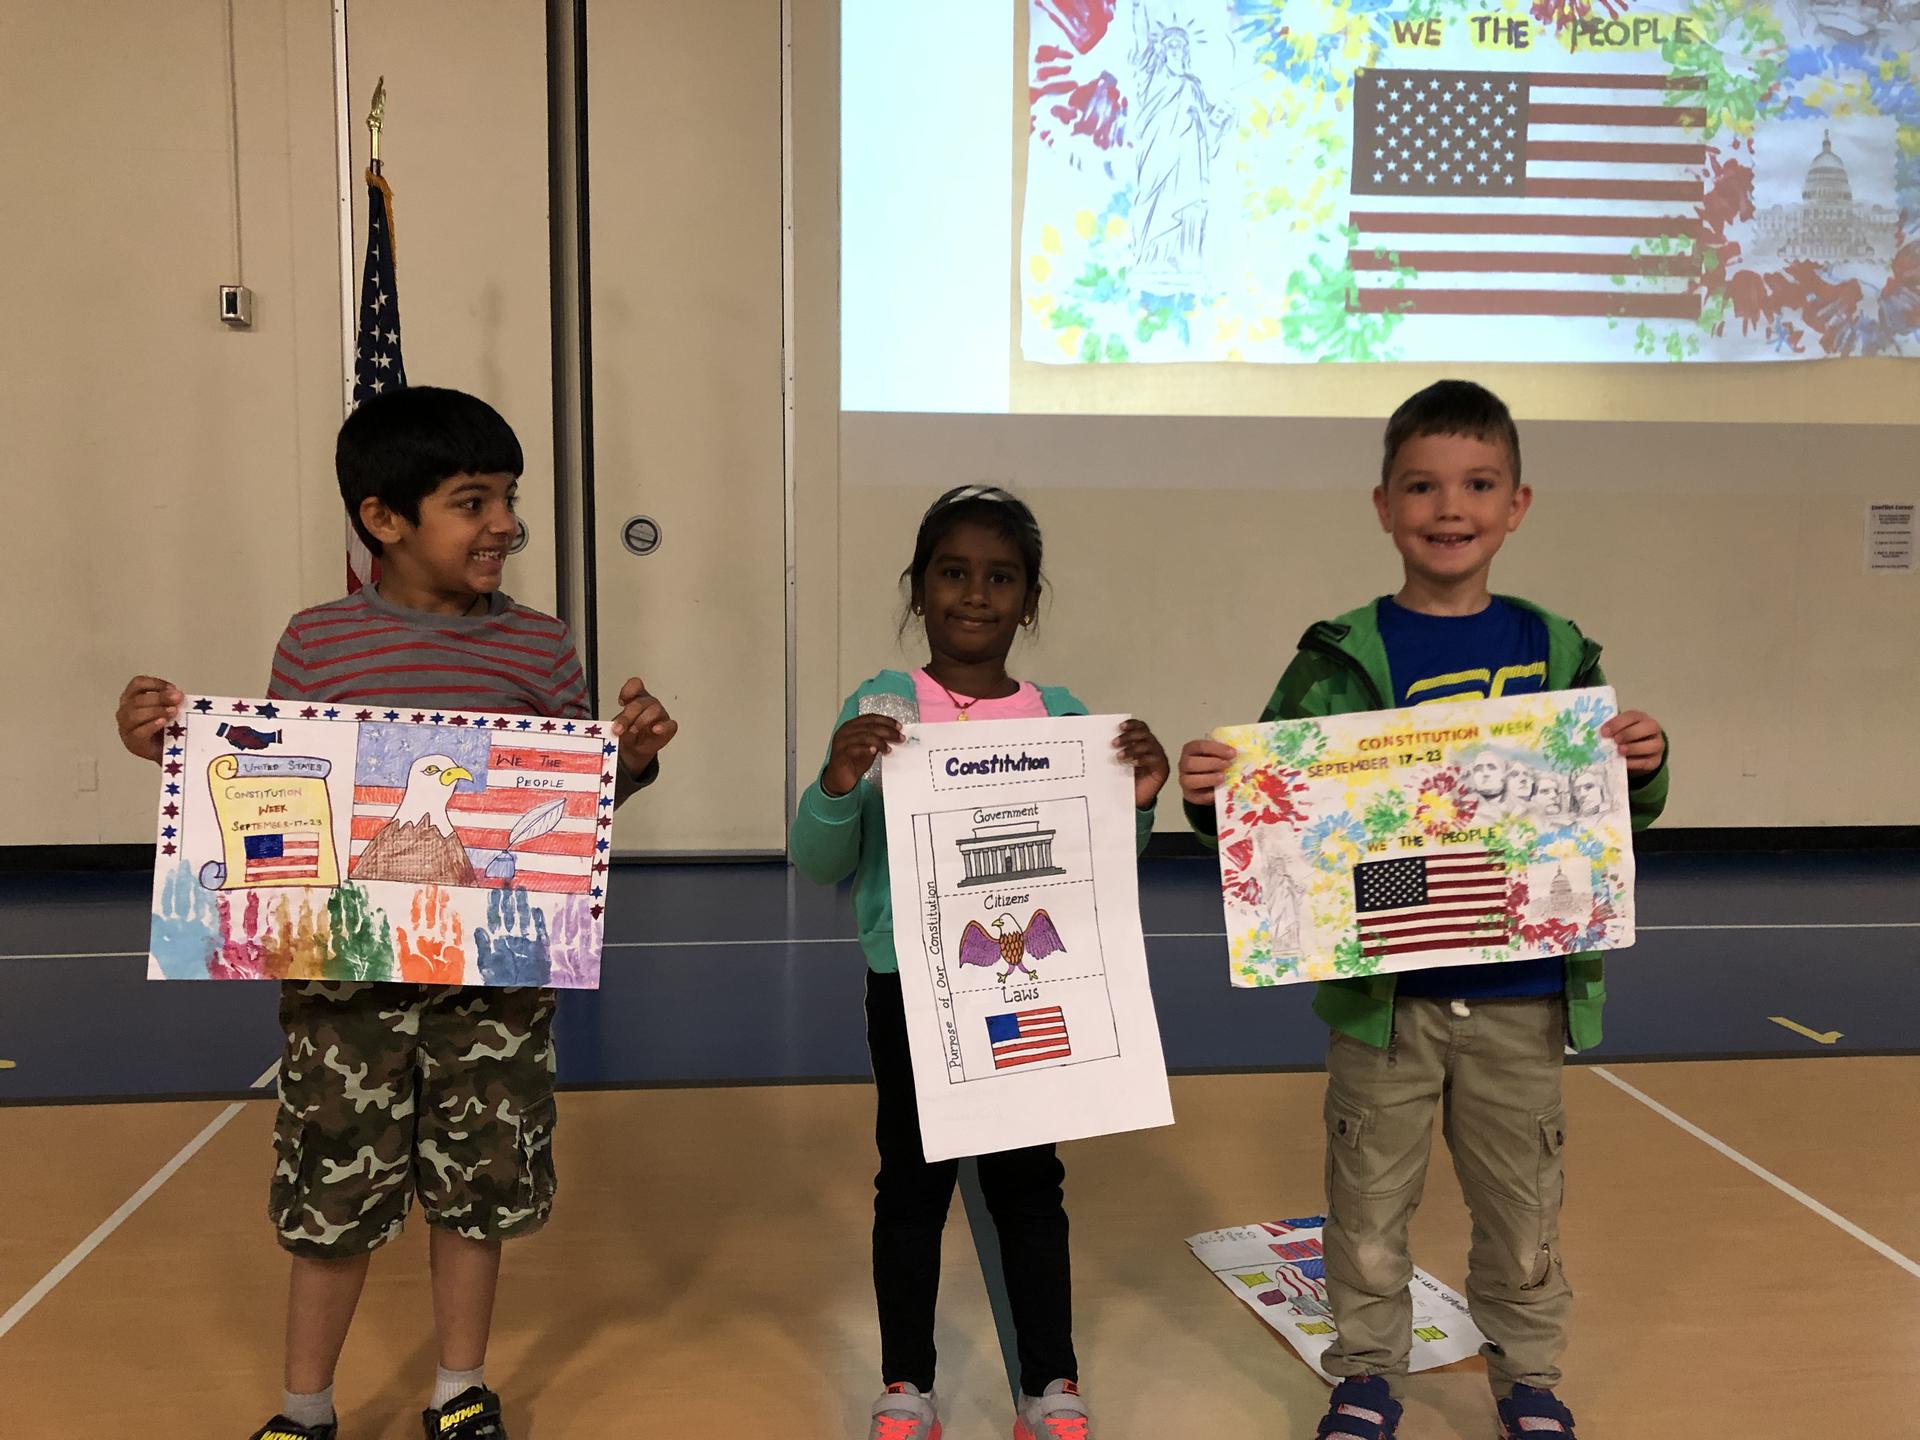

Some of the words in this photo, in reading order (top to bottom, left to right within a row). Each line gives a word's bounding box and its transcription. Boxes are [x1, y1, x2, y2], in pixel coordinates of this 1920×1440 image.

[1393, 18, 1442, 47] WE
[1471, 16, 1530, 49] THE
[1571, 16, 1694, 50] PEOPLE
[1358, 726, 1480, 751] CONSTITUTION
[1489, 719, 1534, 737] WEEK
[244, 763, 279, 773] UNITED
[288, 760, 323, 772] STATES
[496, 753, 523, 767] WE
[540, 755, 562, 768] THE
[945, 751, 1050, 777] Constitution
[1307, 756, 1390, 778] SEPTEMBER
[225, 785, 303, 800] CONSTITUTION
[516, 776, 565, 788] PEOPLE
[258, 804, 288, 816] WEEK
[973, 804, 1039, 824] Government
[1366, 841, 1387, 852] WE
[1400, 834, 1425, 848] THE
[1441, 826, 1498, 846] PEOPLE
[983, 892, 1030, 911] Citizens
[924, 880, 941, 956] Constitution
[936, 966, 947, 989] Our
[938, 997, 950, 1009] of
[1002, 986, 1041, 1004] Laws
[945, 1021, 962, 1069] Purpose
[440, 1402, 484, 1431] BATMAN
